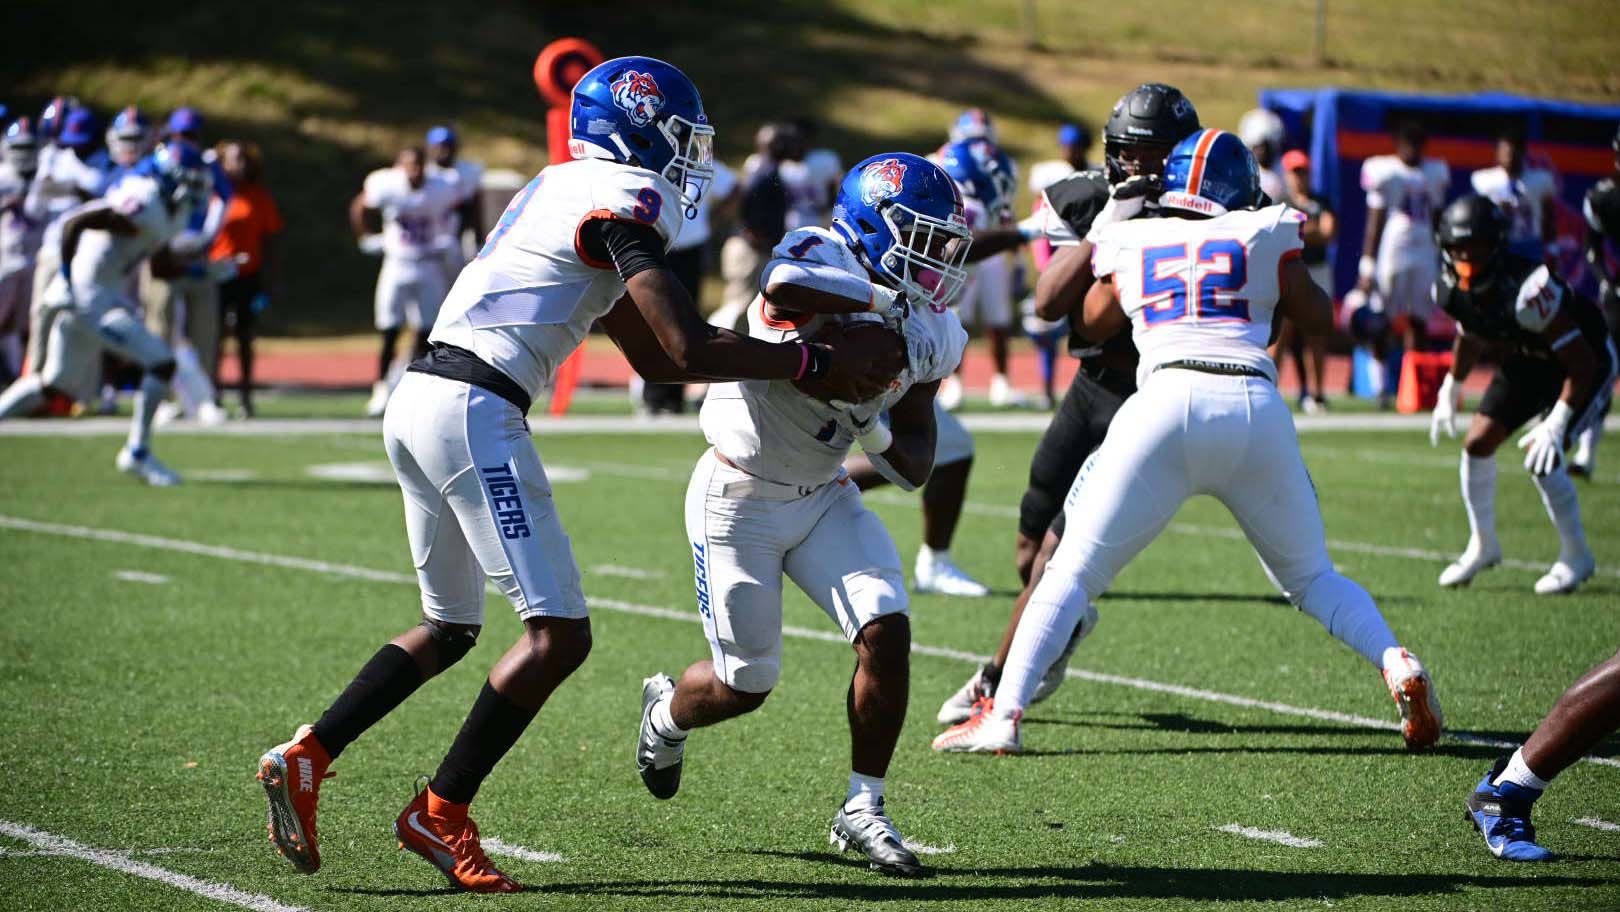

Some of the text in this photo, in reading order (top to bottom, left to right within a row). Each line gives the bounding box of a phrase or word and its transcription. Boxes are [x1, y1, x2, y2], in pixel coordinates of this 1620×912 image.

[634, 187, 662, 224] 9
[788, 235, 825, 259] 1
[1141, 238, 1251, 328] 52
[482, 462, 531, 540] TIGERS
[693, 541, 711, 619] TIGERS
[297, 757, 313, 793] NIKE
